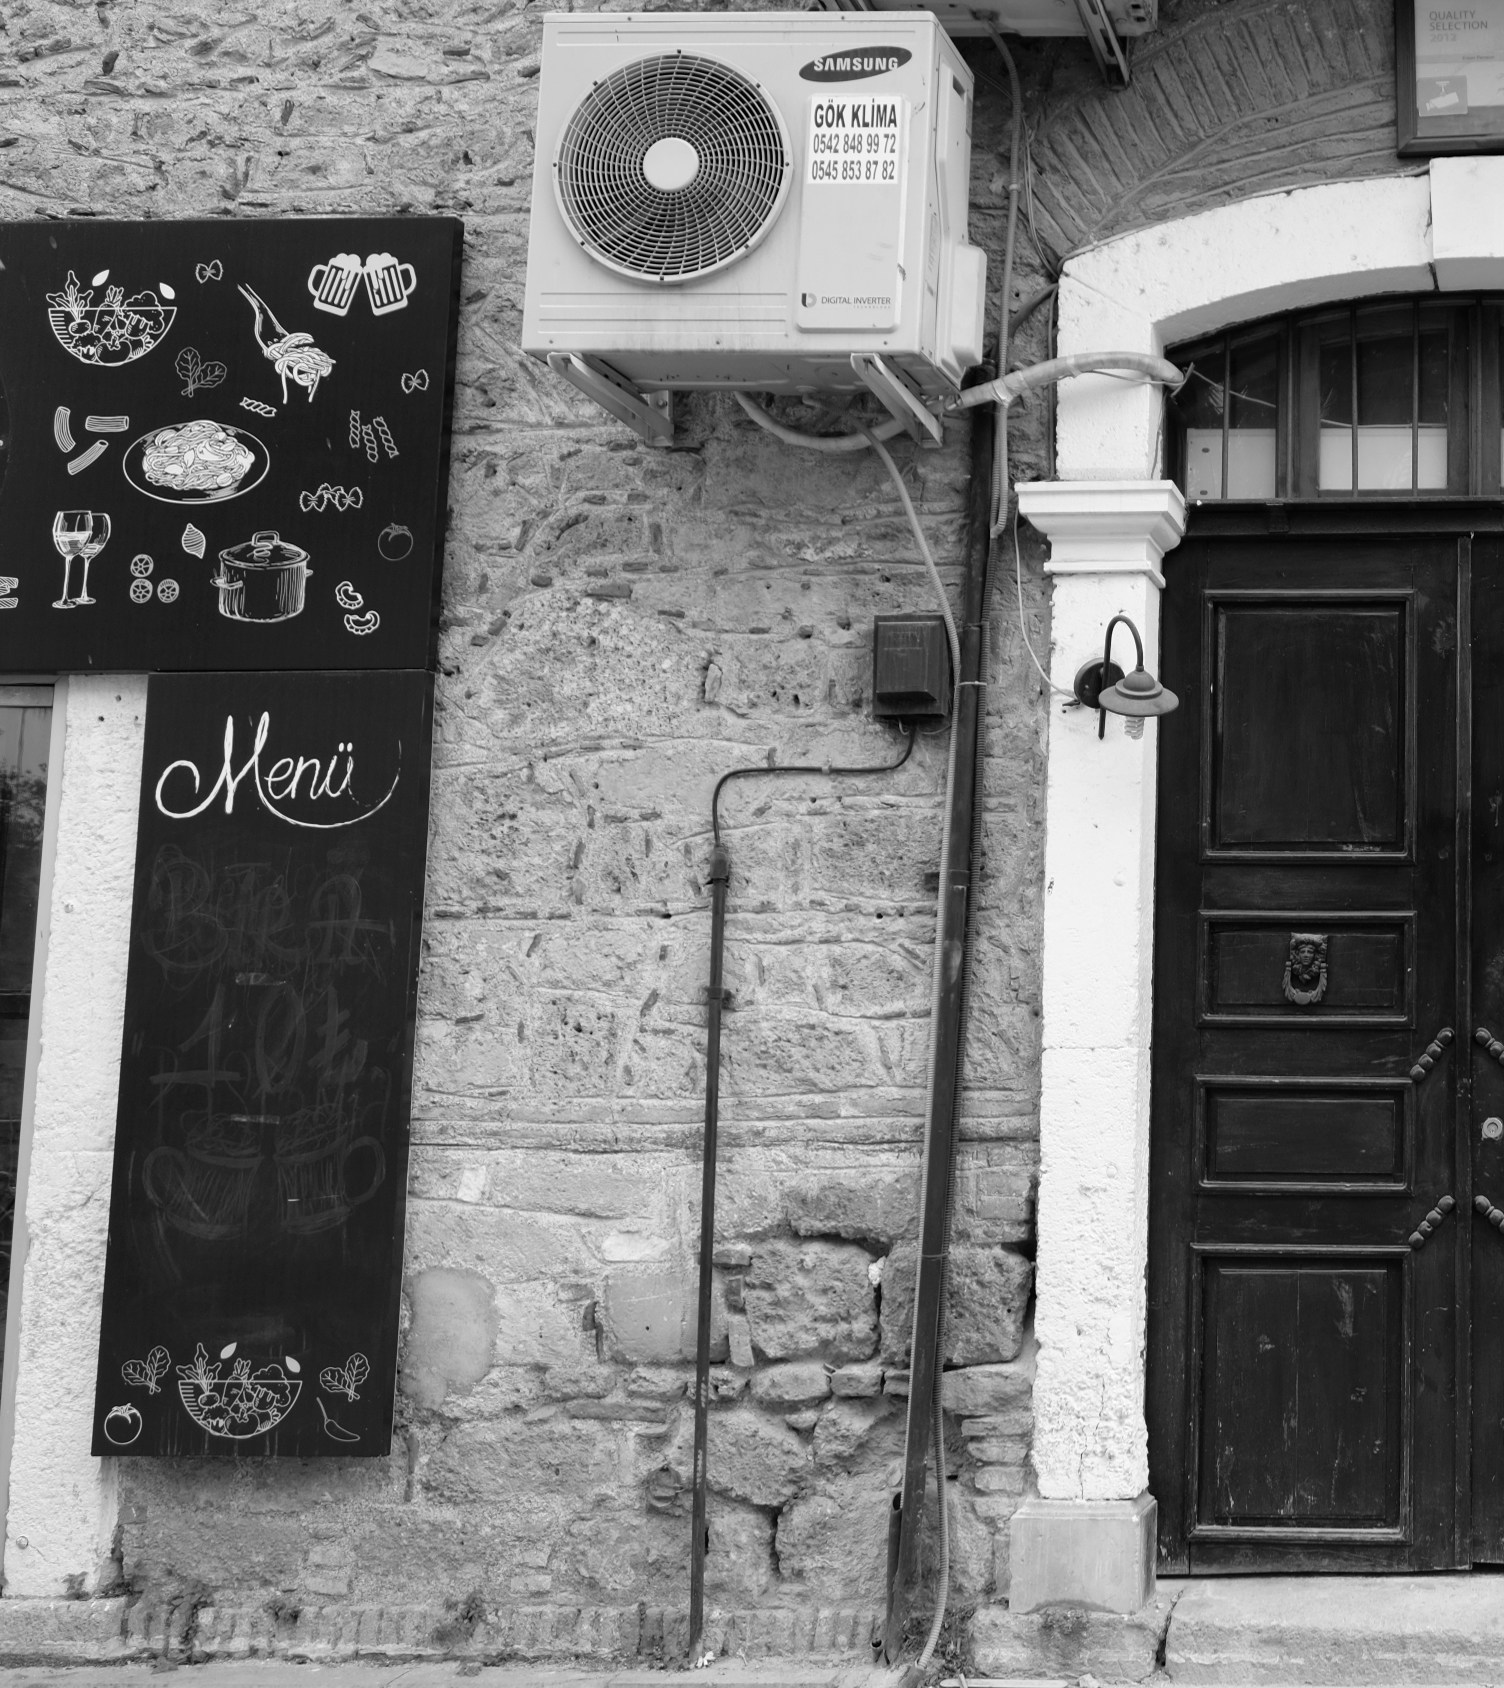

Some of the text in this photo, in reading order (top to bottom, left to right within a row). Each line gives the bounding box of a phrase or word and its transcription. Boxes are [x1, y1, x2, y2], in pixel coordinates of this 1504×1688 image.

[1429, 10, 1476, 21] QUALITY
[1429, 20, 1488, 31] SELECTION
[813, 57, 899, 71] SAMSUNG
[814, 98, 898, 128] GÖK KLİMA
[813, 133, 896, 154] 0542 848 99 72
[811, 160, 895, 180] 0545 853 87 82
[821, 296, 891, 305] DIGITAL INVERTER
[155, 711, 401, 828] Menü
